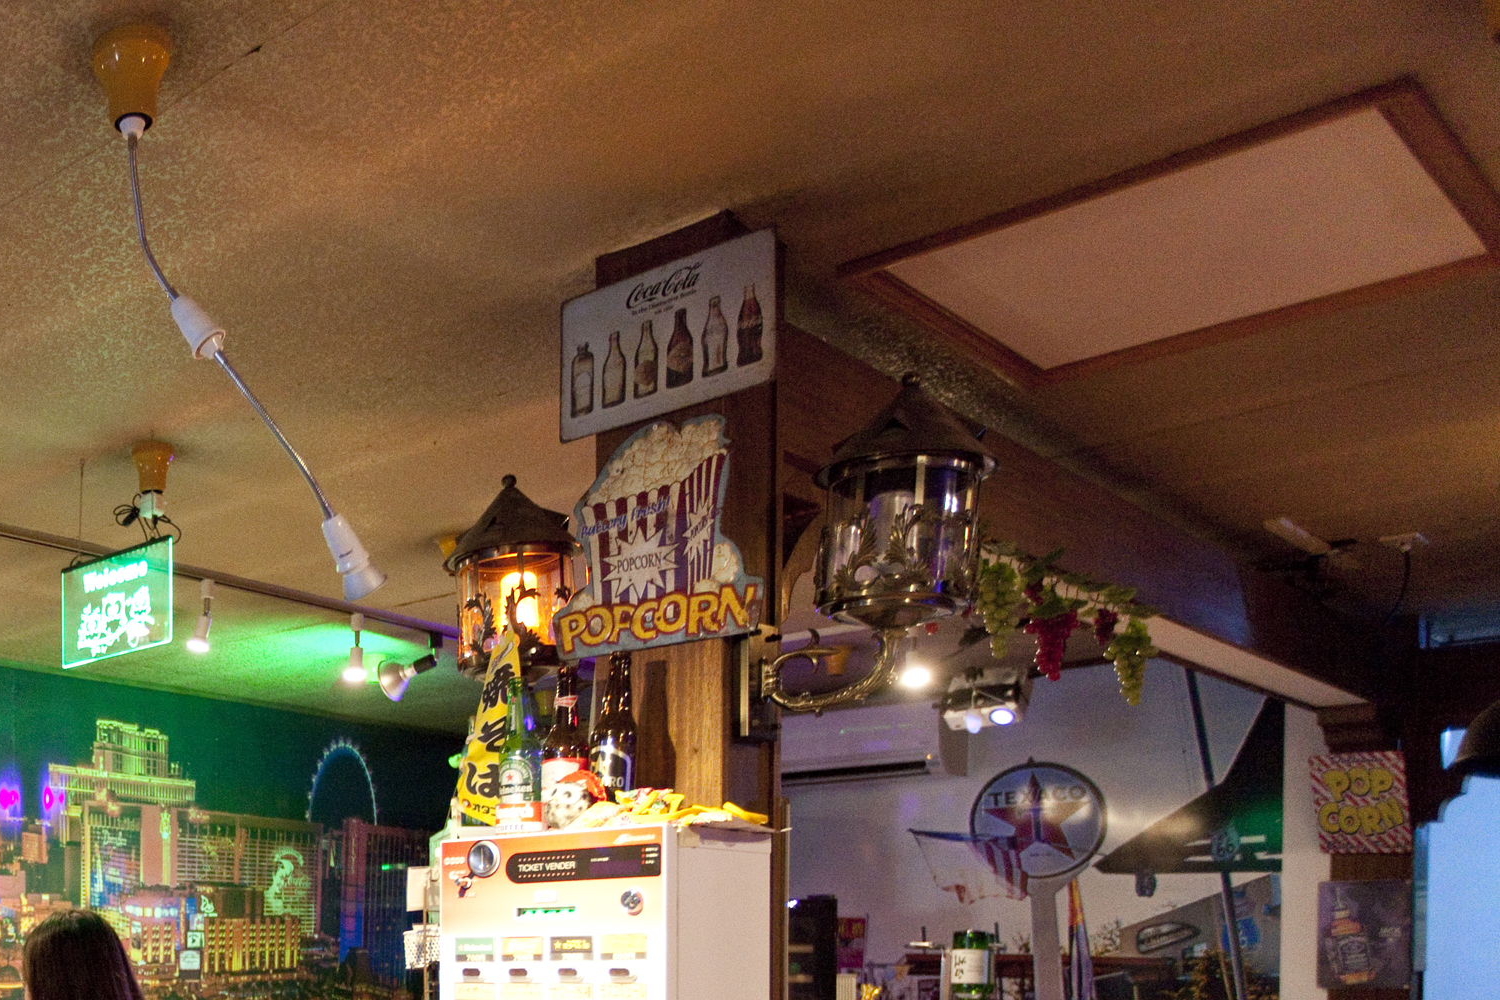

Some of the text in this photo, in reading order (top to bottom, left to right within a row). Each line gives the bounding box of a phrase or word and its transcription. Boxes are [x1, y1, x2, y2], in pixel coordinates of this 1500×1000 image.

[626, 259, 705, 309] Coca-Cola
[617, 552, 663, 574] POPCORN
[559, 585, 758, 655] POPCORN
[1323, 767, 1393, 801] POP
[1318, 799, 1404, 836] CORN
[518, 860, 576, 873] TICKET VENDER
